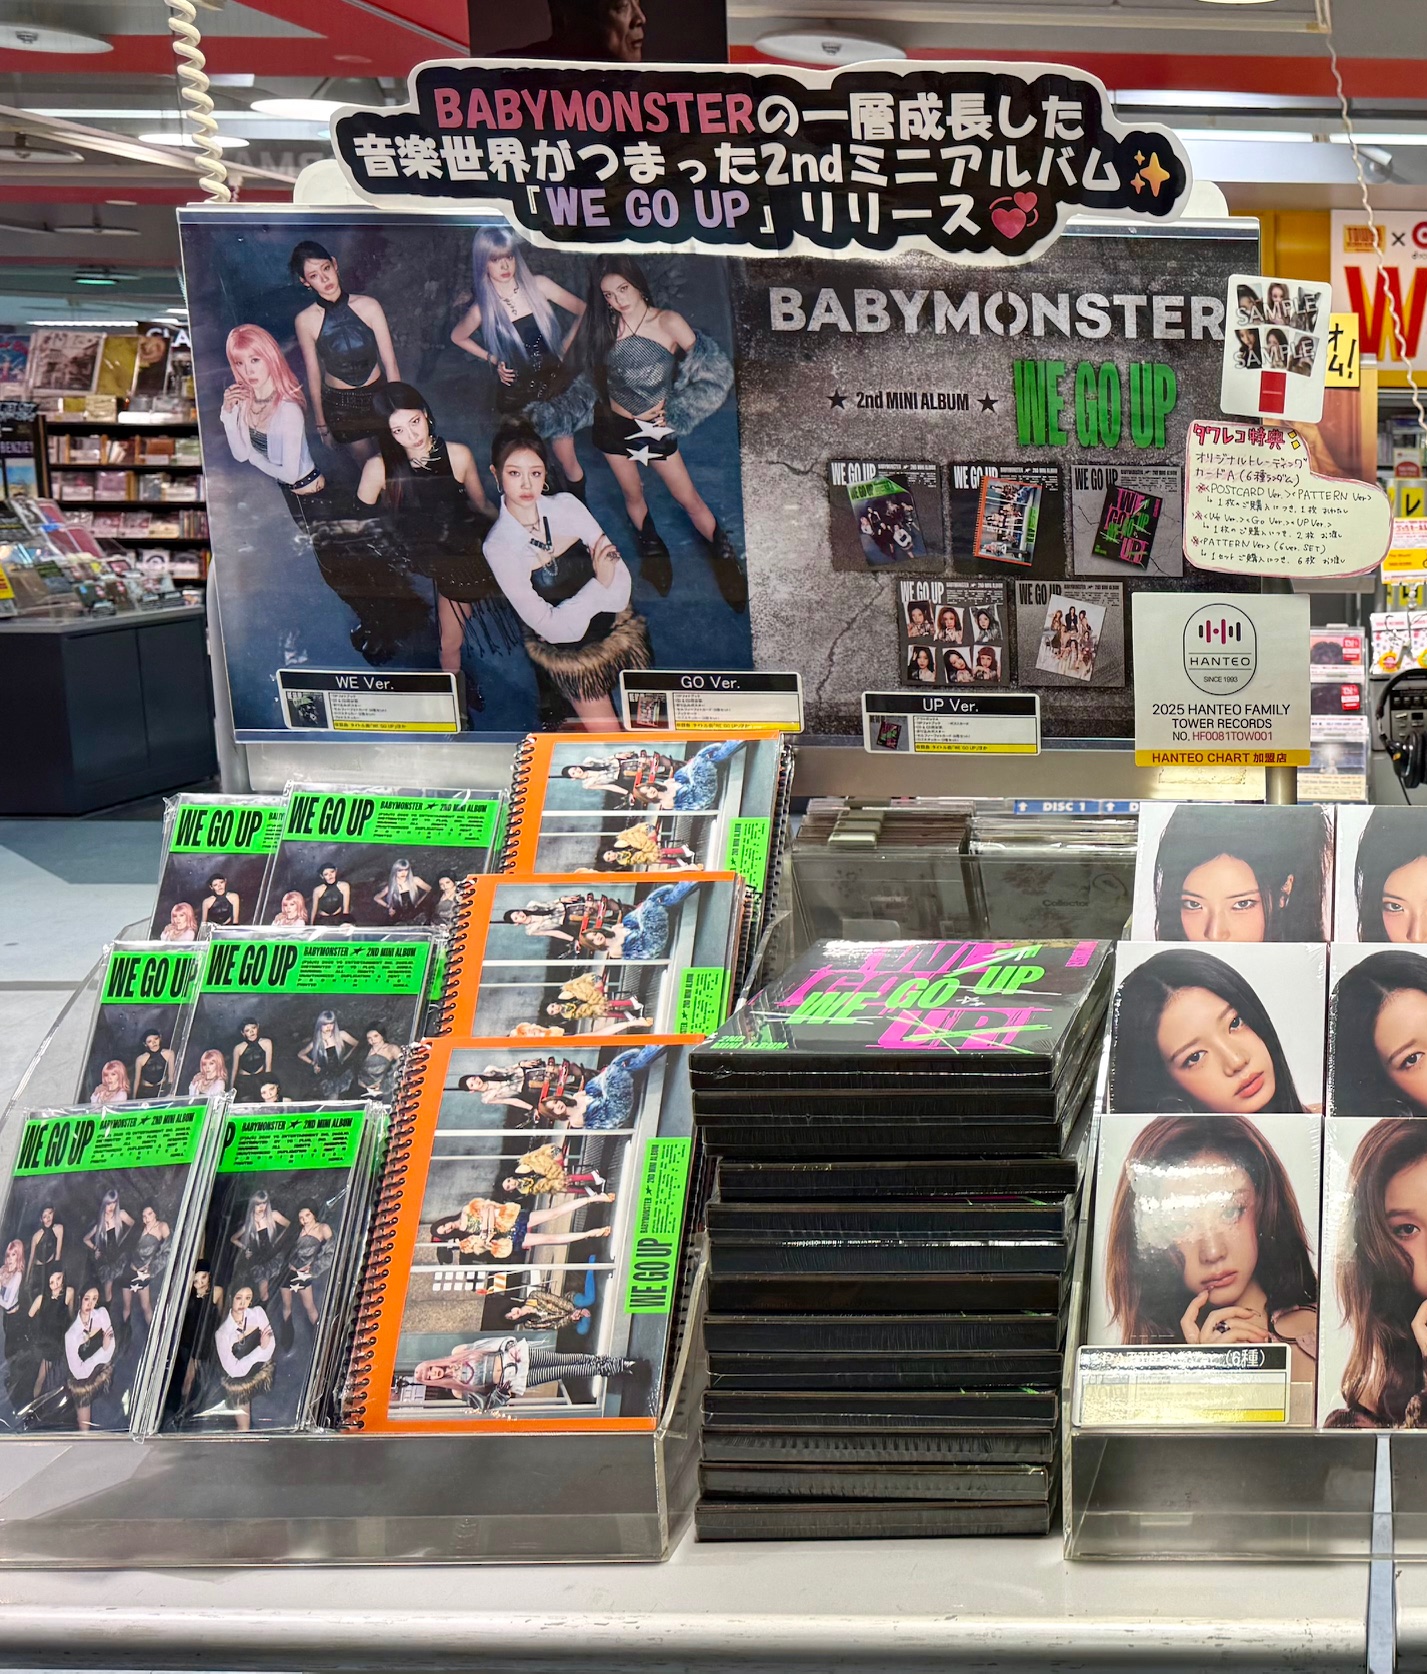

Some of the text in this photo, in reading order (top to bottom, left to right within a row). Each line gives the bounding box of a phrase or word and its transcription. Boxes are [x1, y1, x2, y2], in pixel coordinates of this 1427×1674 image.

[434, 85, 1085, 143] BABYMONSTERの一層成長した
[353, 134, 1122, 189] 音楽世界がつまった2ndミニアルバム
[770, 286, 1225, 342] BABYMONSTER
[1236, 294, 1318, 327] SAMPLE
[1232, 338, 1314, 370] SAMPLE
[856, 390, 970, 412] 2nd MINI ALBUM
[1013, 359, 1178, 449] WE GO UP
[1192, 424, 1286, 450] タワレコ特典
[831, 462, 847, 485] WE
[953, 465, 969, 489] WE
[1075, 467, 1089, 490] WE
[1091, 468, 1103, 490] GO
[900, 580, 915, 602] WE
[916, 581, 930, 601] GO
[931, 581, 945, 604] UP
[1019, 583, 1033, 605] WE
[1035, 583, 1047, 605] GO
[1189, 656, 1251, 667] HANTEO
[336, 676, 395, 690] WE Ver.
[680, 675, 741, 690] GO Ver.
[922, 698, 979, 713] UP Ver.
[1152, 703, 1291, 716] 2025 HANTEO FAMILY
[1172, 718, 1273, 729] TOWER RECORDS
[1172, 731, 1274, 742] NO. HF0081TOW001
[1151, 751, 1288, 764] HANTEO CHART 加盟店
[286, 796, 319, 835] WE
[318, 797, 347, 836] GO
[346, 799, 375, 837] UP
[380, 800, 423, 811] BABYMONSTER
[1042, 802, 1086, 812] DISC 1
[175, 809, 207, 848] WE
[206, 810, 234, 848] GO
[234, 811, 263, 849] UP
[303, 946, 349, 957] BABYMONSTER
[206, 943, 241, 986] WE
[238, 944, 268, 987] GO
[267, 944, 298, 987] UP
[107, 957, 142, 998] WE
[140, 957, 170, 999] GO
[974, 965, 1046, 996] UP
[884, 977, 960, 1009] GO
[16, 1122, 49, 1170] WE
[47, 1121, 71, 1168] GO
[68, 1119, 95, 1166] UP
[640, 1197, 653, 1234] BABYMONSTER
[636, 1237, 673, 1258] UP
[632, 1260, 671, 1282] GO
[629, 1285, 668, 1308] WE
